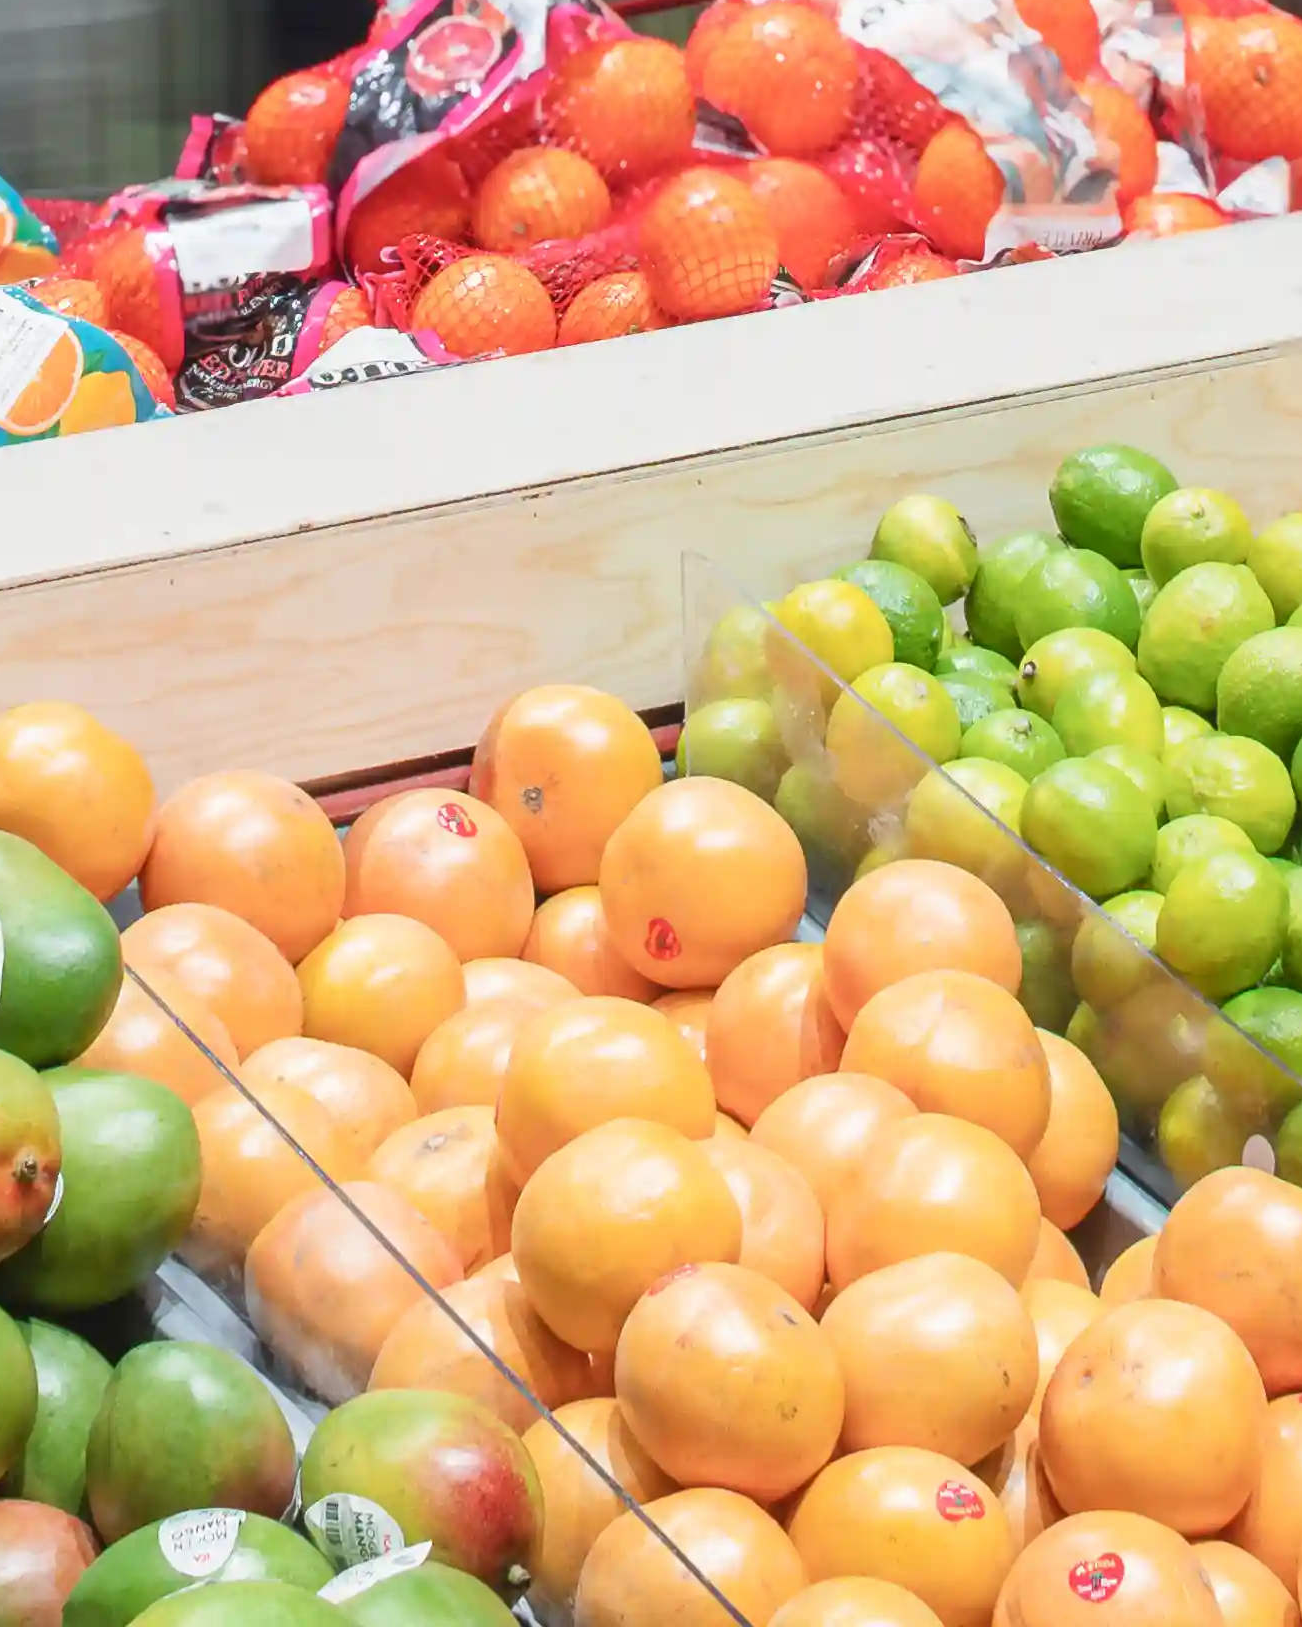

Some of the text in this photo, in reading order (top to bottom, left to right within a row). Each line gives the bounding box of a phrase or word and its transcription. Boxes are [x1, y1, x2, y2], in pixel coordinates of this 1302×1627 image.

[352, 1511, 370, 1562] MANG
[364, 1512, 379, 1560] MOGE
[382, 1533, 392, 1554] ICA
